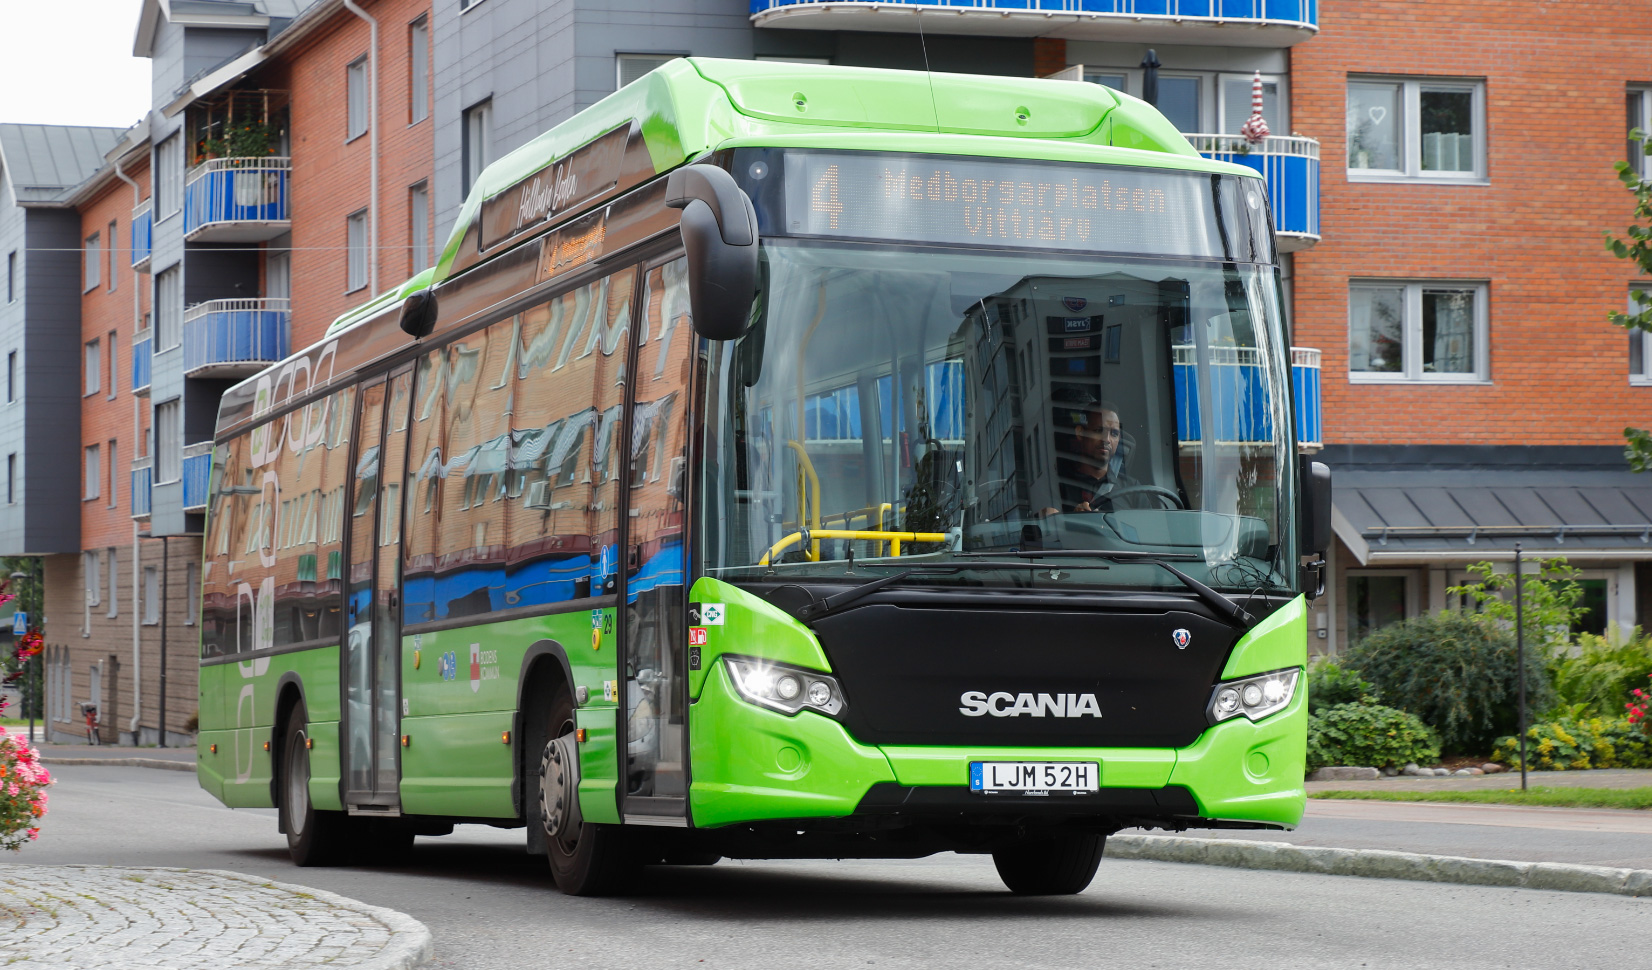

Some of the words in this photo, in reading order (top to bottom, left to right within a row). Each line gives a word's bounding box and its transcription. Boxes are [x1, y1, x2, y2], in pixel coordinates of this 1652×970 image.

[811, 163, 844, 230] 4
[603, 613, 613, 635] 29
[706, 610, 718, 618] CNG
[959, 691, 1103, 718] SCANIA
[992, 765, 1036, 787] LJM
[1044, 766, 1088, 787] 52H
